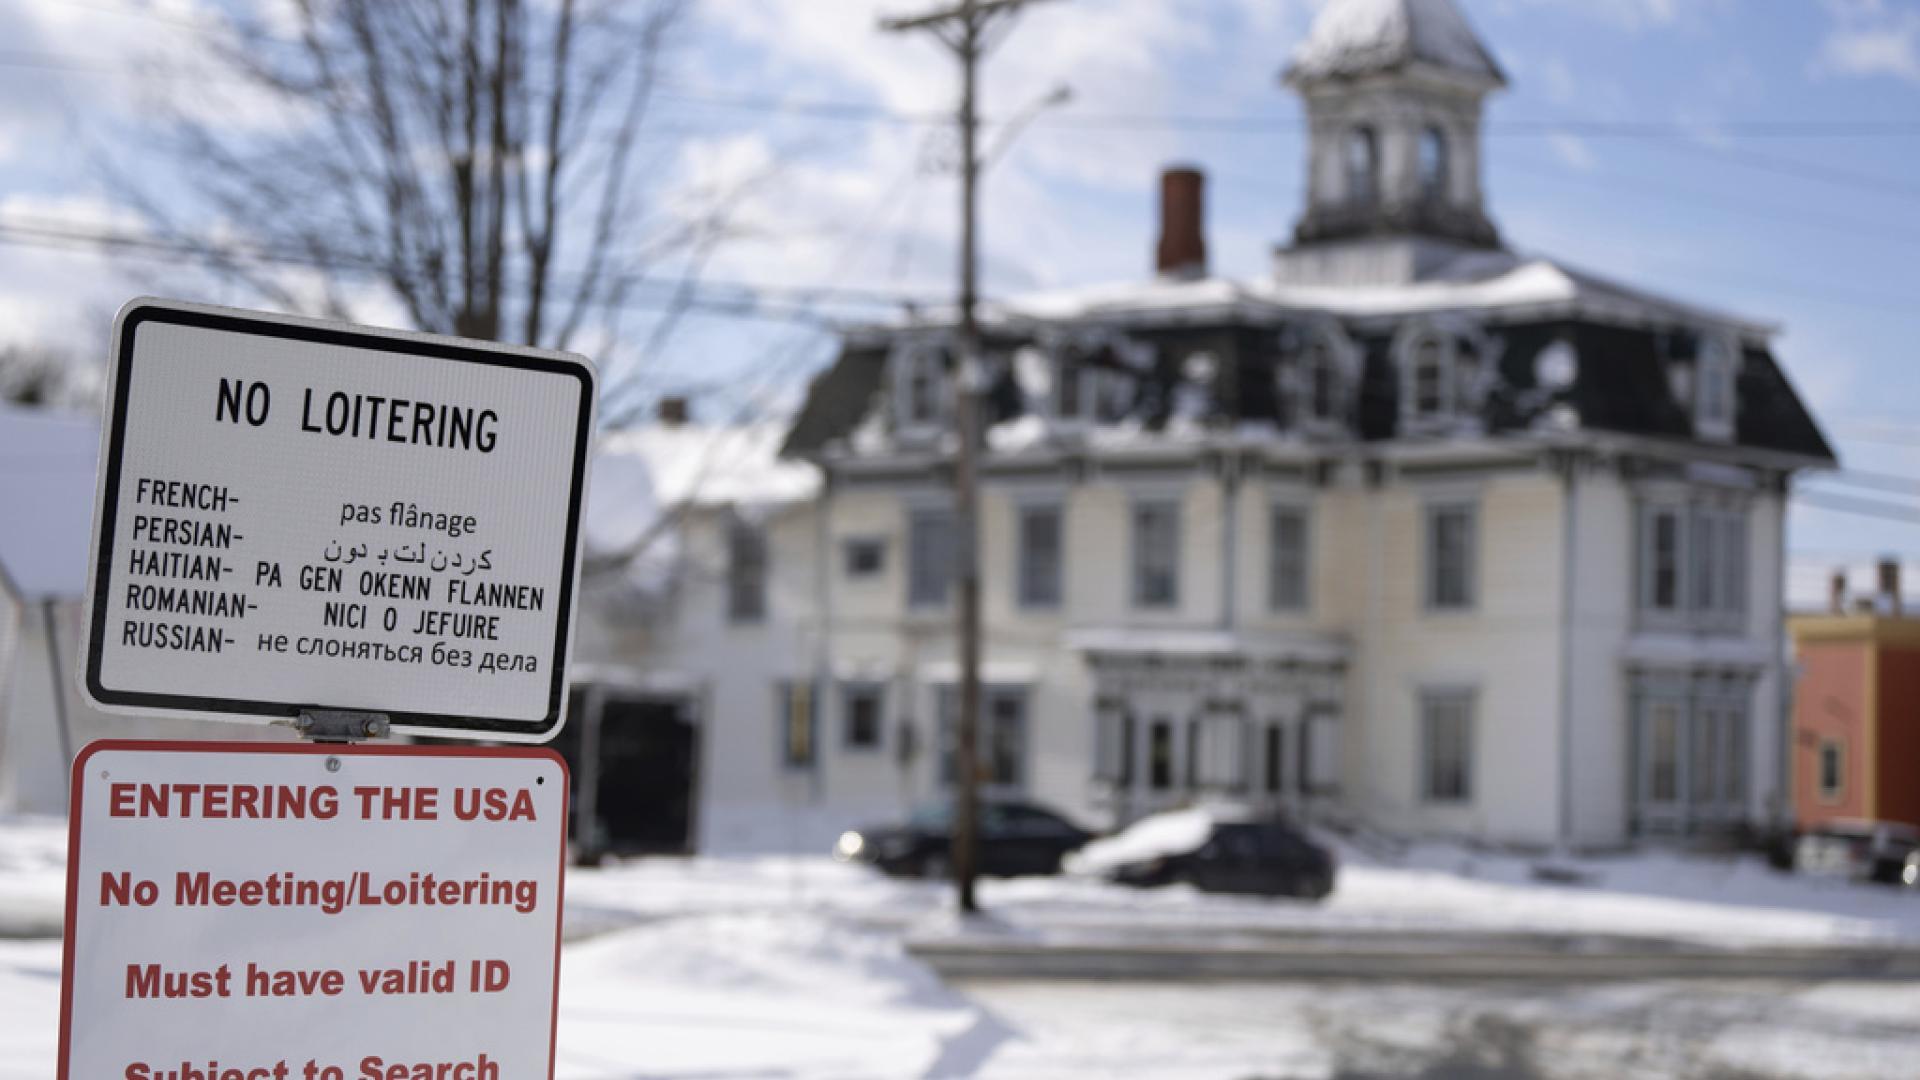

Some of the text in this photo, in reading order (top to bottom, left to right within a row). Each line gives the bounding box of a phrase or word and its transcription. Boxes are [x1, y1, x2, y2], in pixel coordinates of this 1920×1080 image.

[215, 376, 499, 454] NO LOITERING
[136, 477, 477, 538] FRENCH- pas flânage
[132, 514, 244, 549] PERSIAN-
[128, 548, 545, 611] HAITIAN- PA GEN OKENN FLANNEN
[125, 583, 258, 619] ROMANIAN-
[323, 601, 367, 630] NICI
[412, 609, 501, 641] JEFUIRE
[121, 620, 235, 654] RUSSIAN-
[257, 633, 537, 674] не слоняться без дела
[109, 783, 537, 821] ENTERING THE USA
[100, 871, 537, 915] No Meeting/Loitering
[125, 959, 511, 999] Must have valid ID
[303, 1059, 344, 1080] to
[358, 1053, 498, 1080] Search
